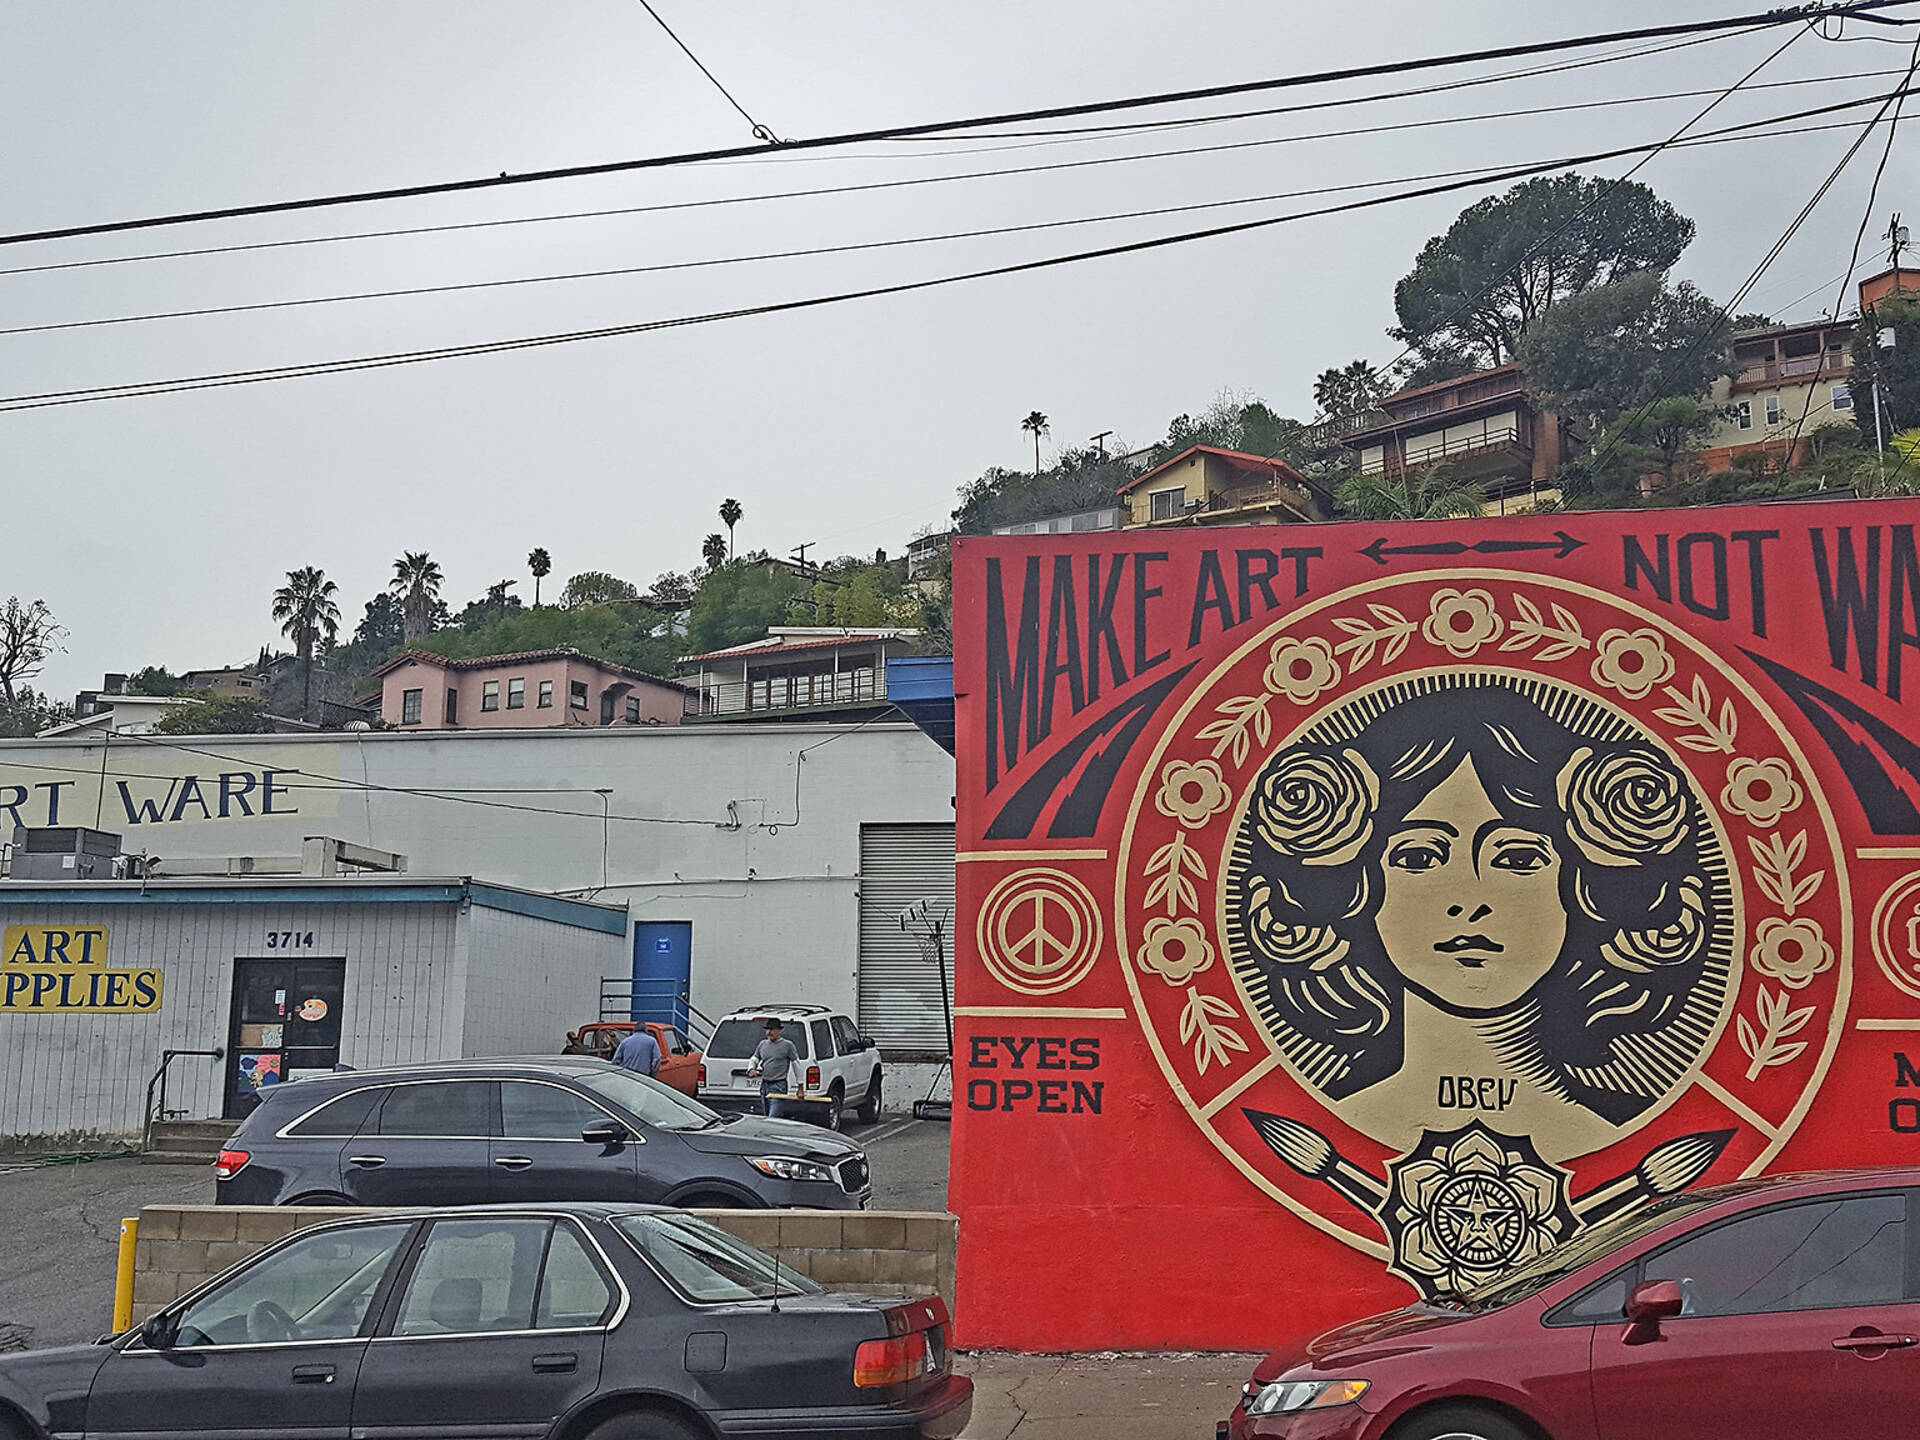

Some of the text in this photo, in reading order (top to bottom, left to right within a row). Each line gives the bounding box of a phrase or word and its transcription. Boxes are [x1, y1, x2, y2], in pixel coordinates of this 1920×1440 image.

[986, 552, 1171, 798] MAKE
[1186, 547, 1323, 650] ART
[1622, 530, 1780, 639] NOT
[116, 769, 300, 824] WARE
[8, 930, 103, 964] ART
[267, 931, 313, 948] 3714
[0, 972, 157, 1008] PPLIES
[969, 1036, 1100, 1070] EYES
[968, 1080, 1105, 1114] OPEN
[1437, 1076, 1519, 1111] OBEY
